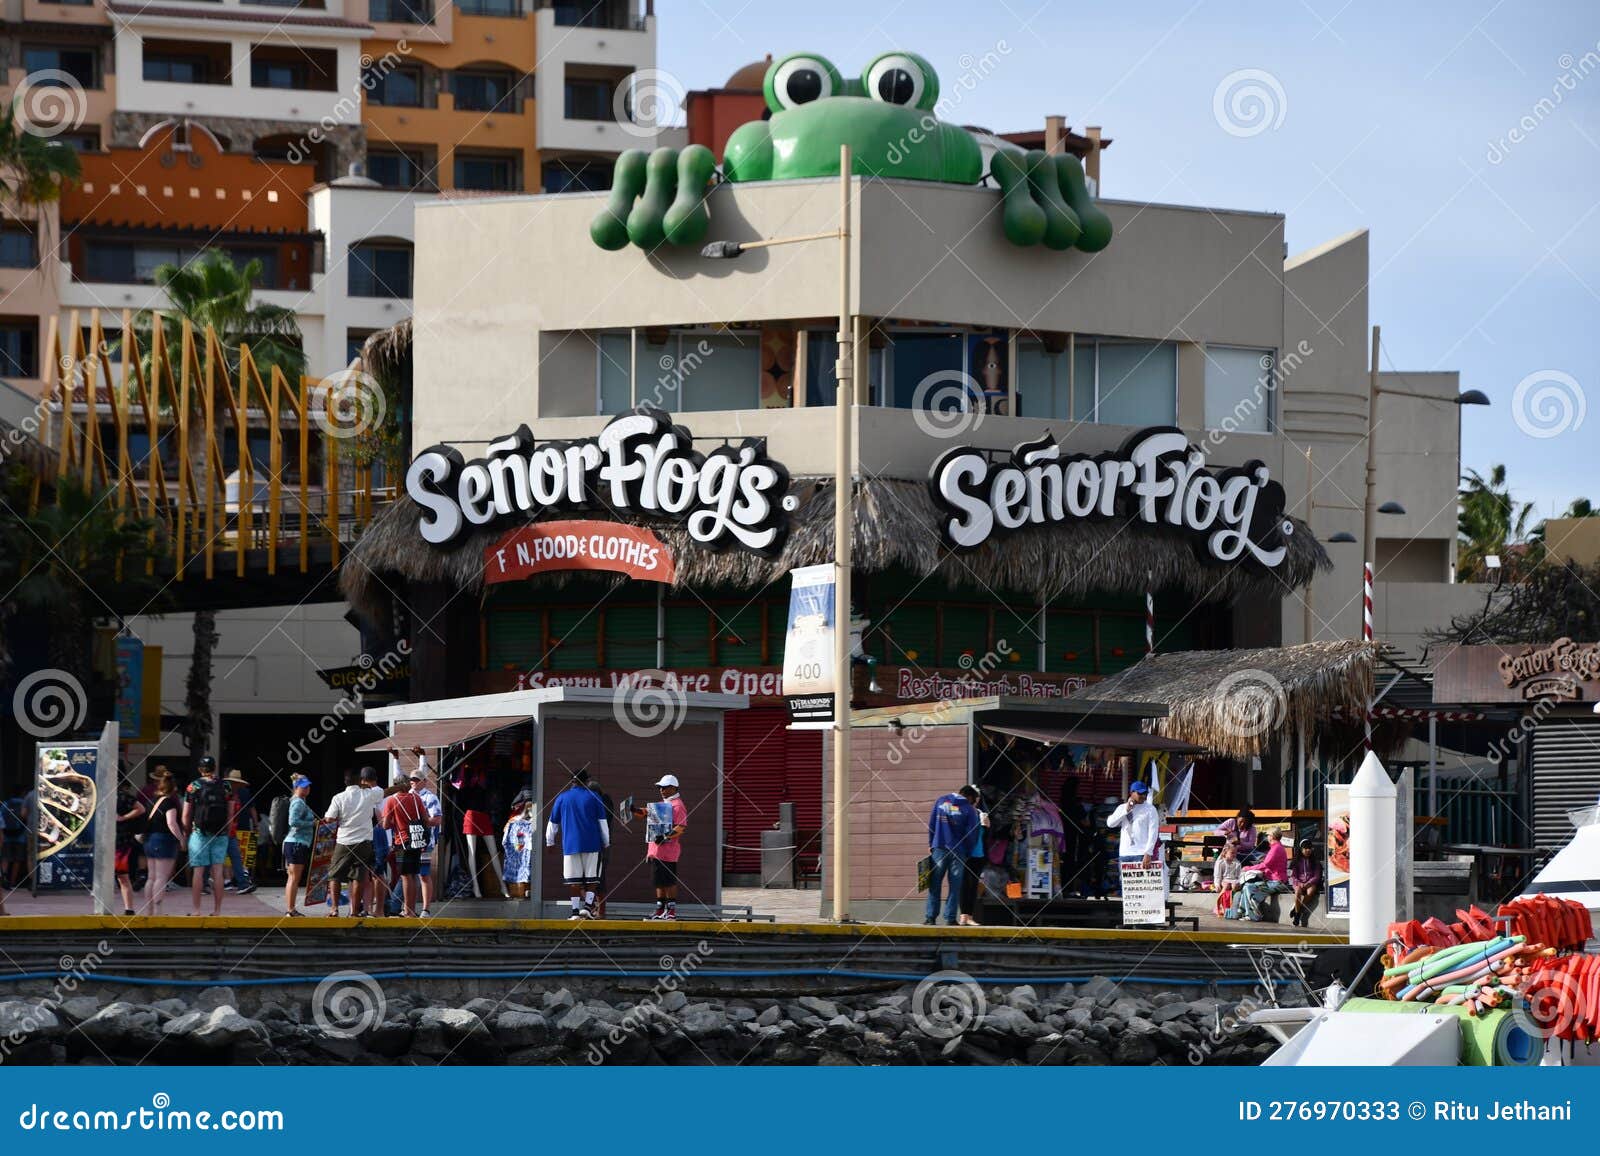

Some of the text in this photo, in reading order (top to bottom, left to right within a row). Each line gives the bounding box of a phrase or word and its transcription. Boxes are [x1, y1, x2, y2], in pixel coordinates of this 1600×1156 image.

[405, 435, 602, 544] Señor
[599, 415, 779, 549] Frog's
[939, 444, 1136, 547] Señor
[589, 535, 659, 571] CLOTHES
[662, 671, 709, 694] Are
[794, 663, 821, 680] 400
[409, 824, 424, 833] KISS
[411, 832, 424, 841] MY
